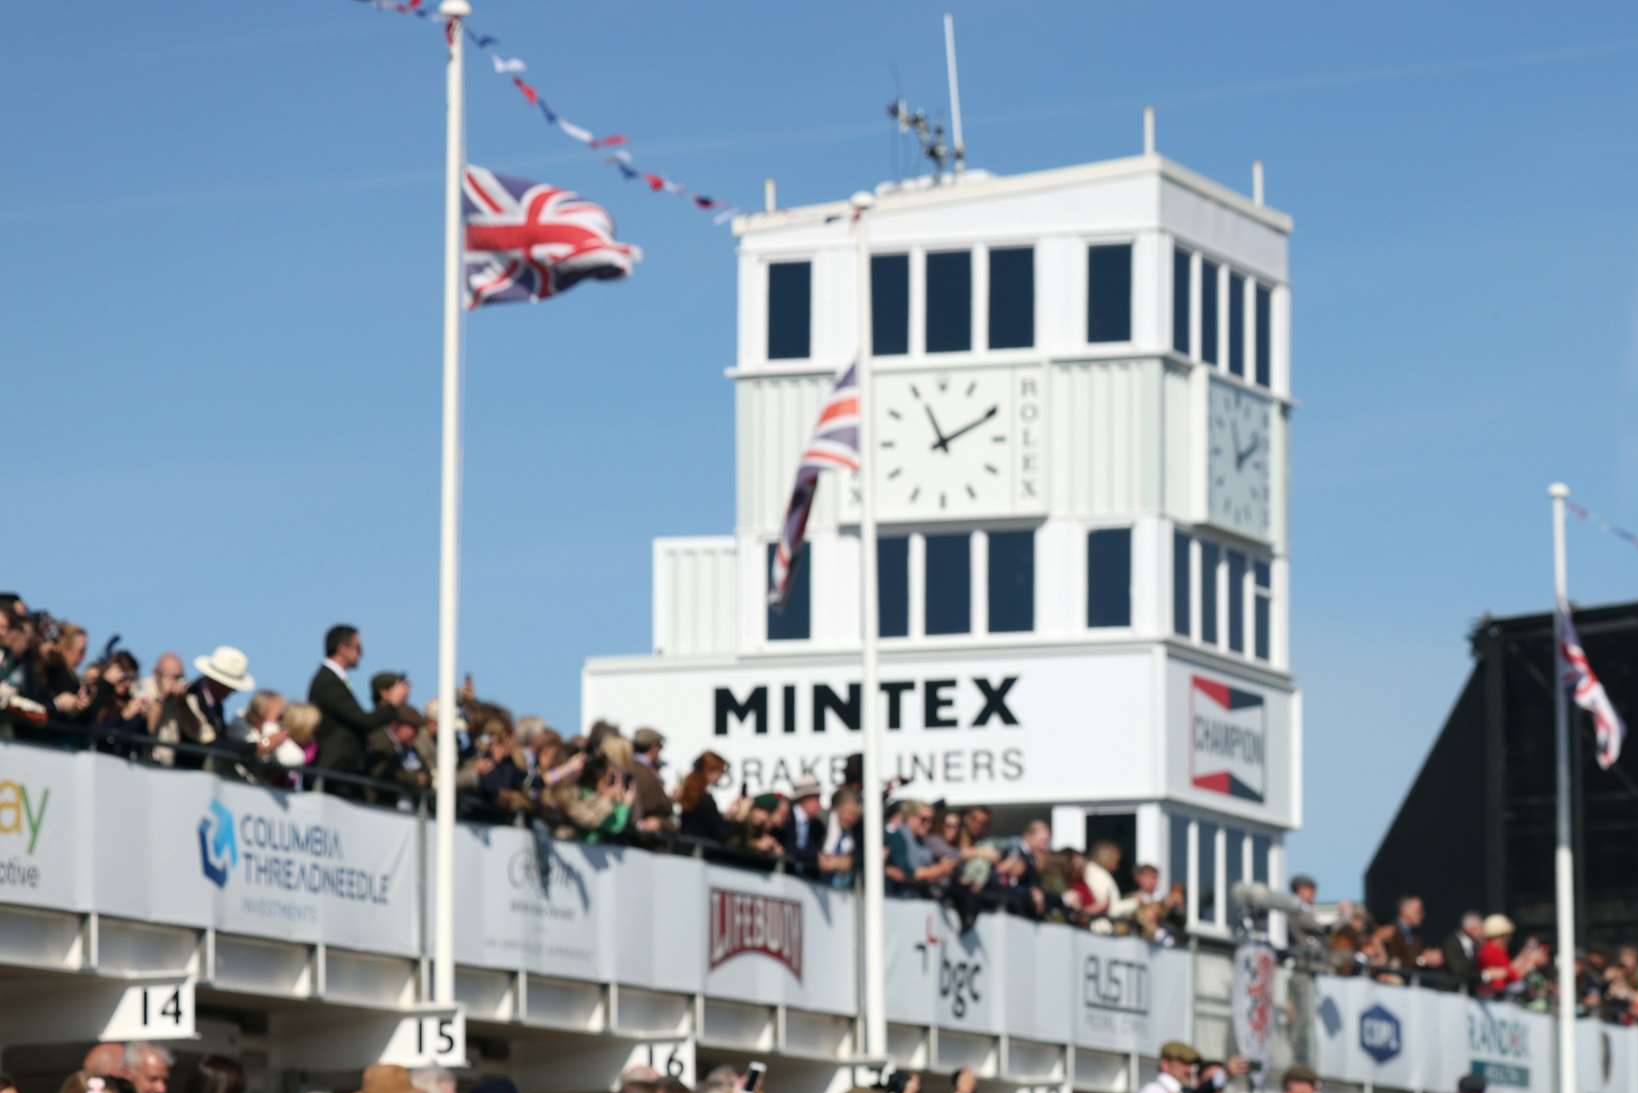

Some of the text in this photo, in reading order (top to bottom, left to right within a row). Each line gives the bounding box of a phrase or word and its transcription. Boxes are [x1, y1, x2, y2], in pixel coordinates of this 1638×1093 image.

[1021, 378, 1037, 497] ROLEX
[714, 676, 1020, 735] MINTEX
[1194, 716, 1264, 765] CHAMPION
[895, 749, 1024, 784] INERS
[240, 815, 343, 859] COLUMBIA
[244, 853, 391, 904] THREADNEEDLE
[939, 940, 982, 1018] bgc
[142, 986, 182, 1026] 14
[417, 1016, 454, 1054] 15
[647, 1042, 684, 1079] 16
